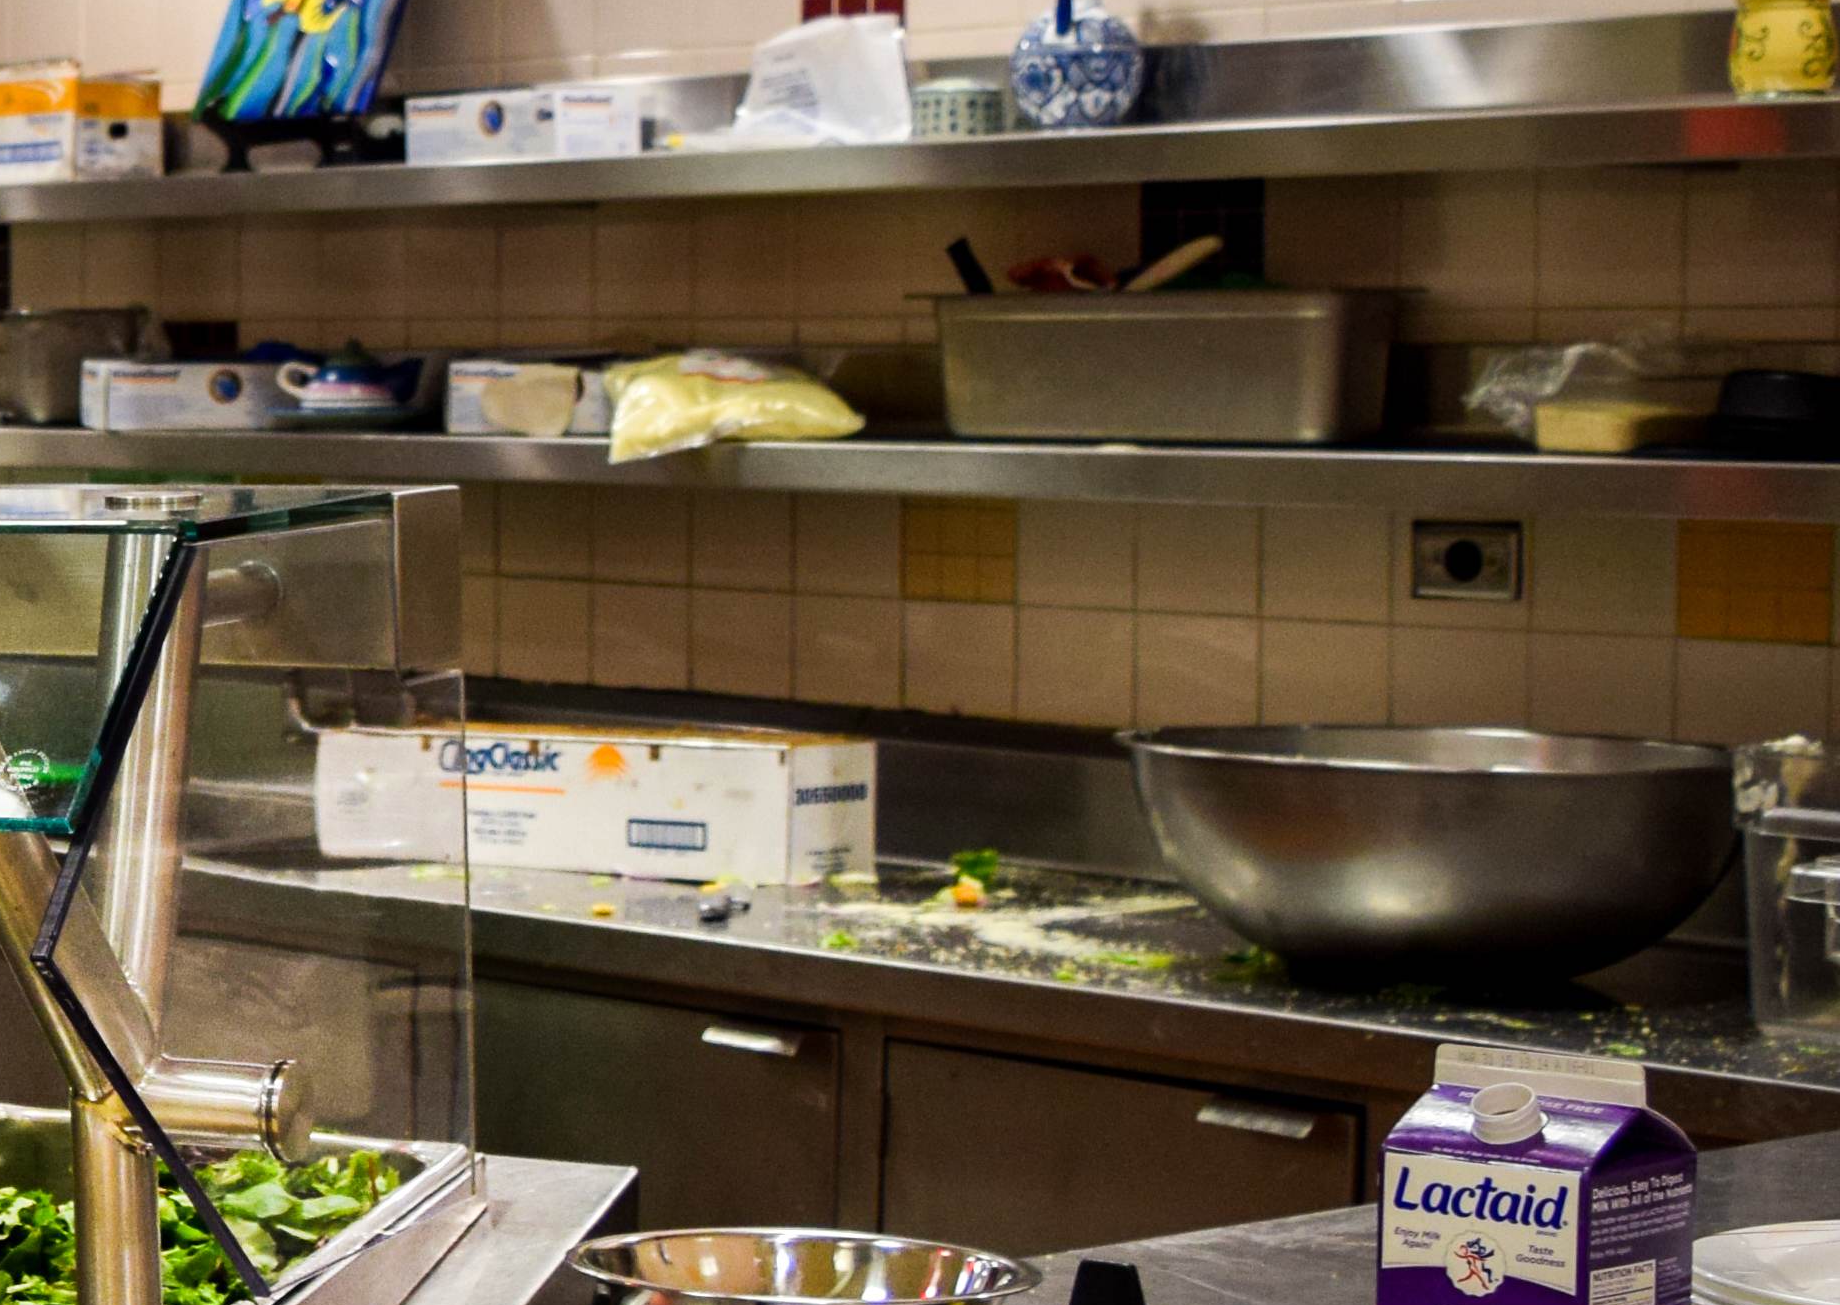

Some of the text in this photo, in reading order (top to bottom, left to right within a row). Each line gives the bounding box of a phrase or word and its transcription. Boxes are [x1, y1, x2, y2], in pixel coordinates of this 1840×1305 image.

[1393, 1166, 1567, 1230] Lactaid
[1394, 1226, 1441, 1241] Enjoy Milk
[1529, 1244, 1554, 1256] Taste
[1515, 1254, 1566, 1268] Goodness
